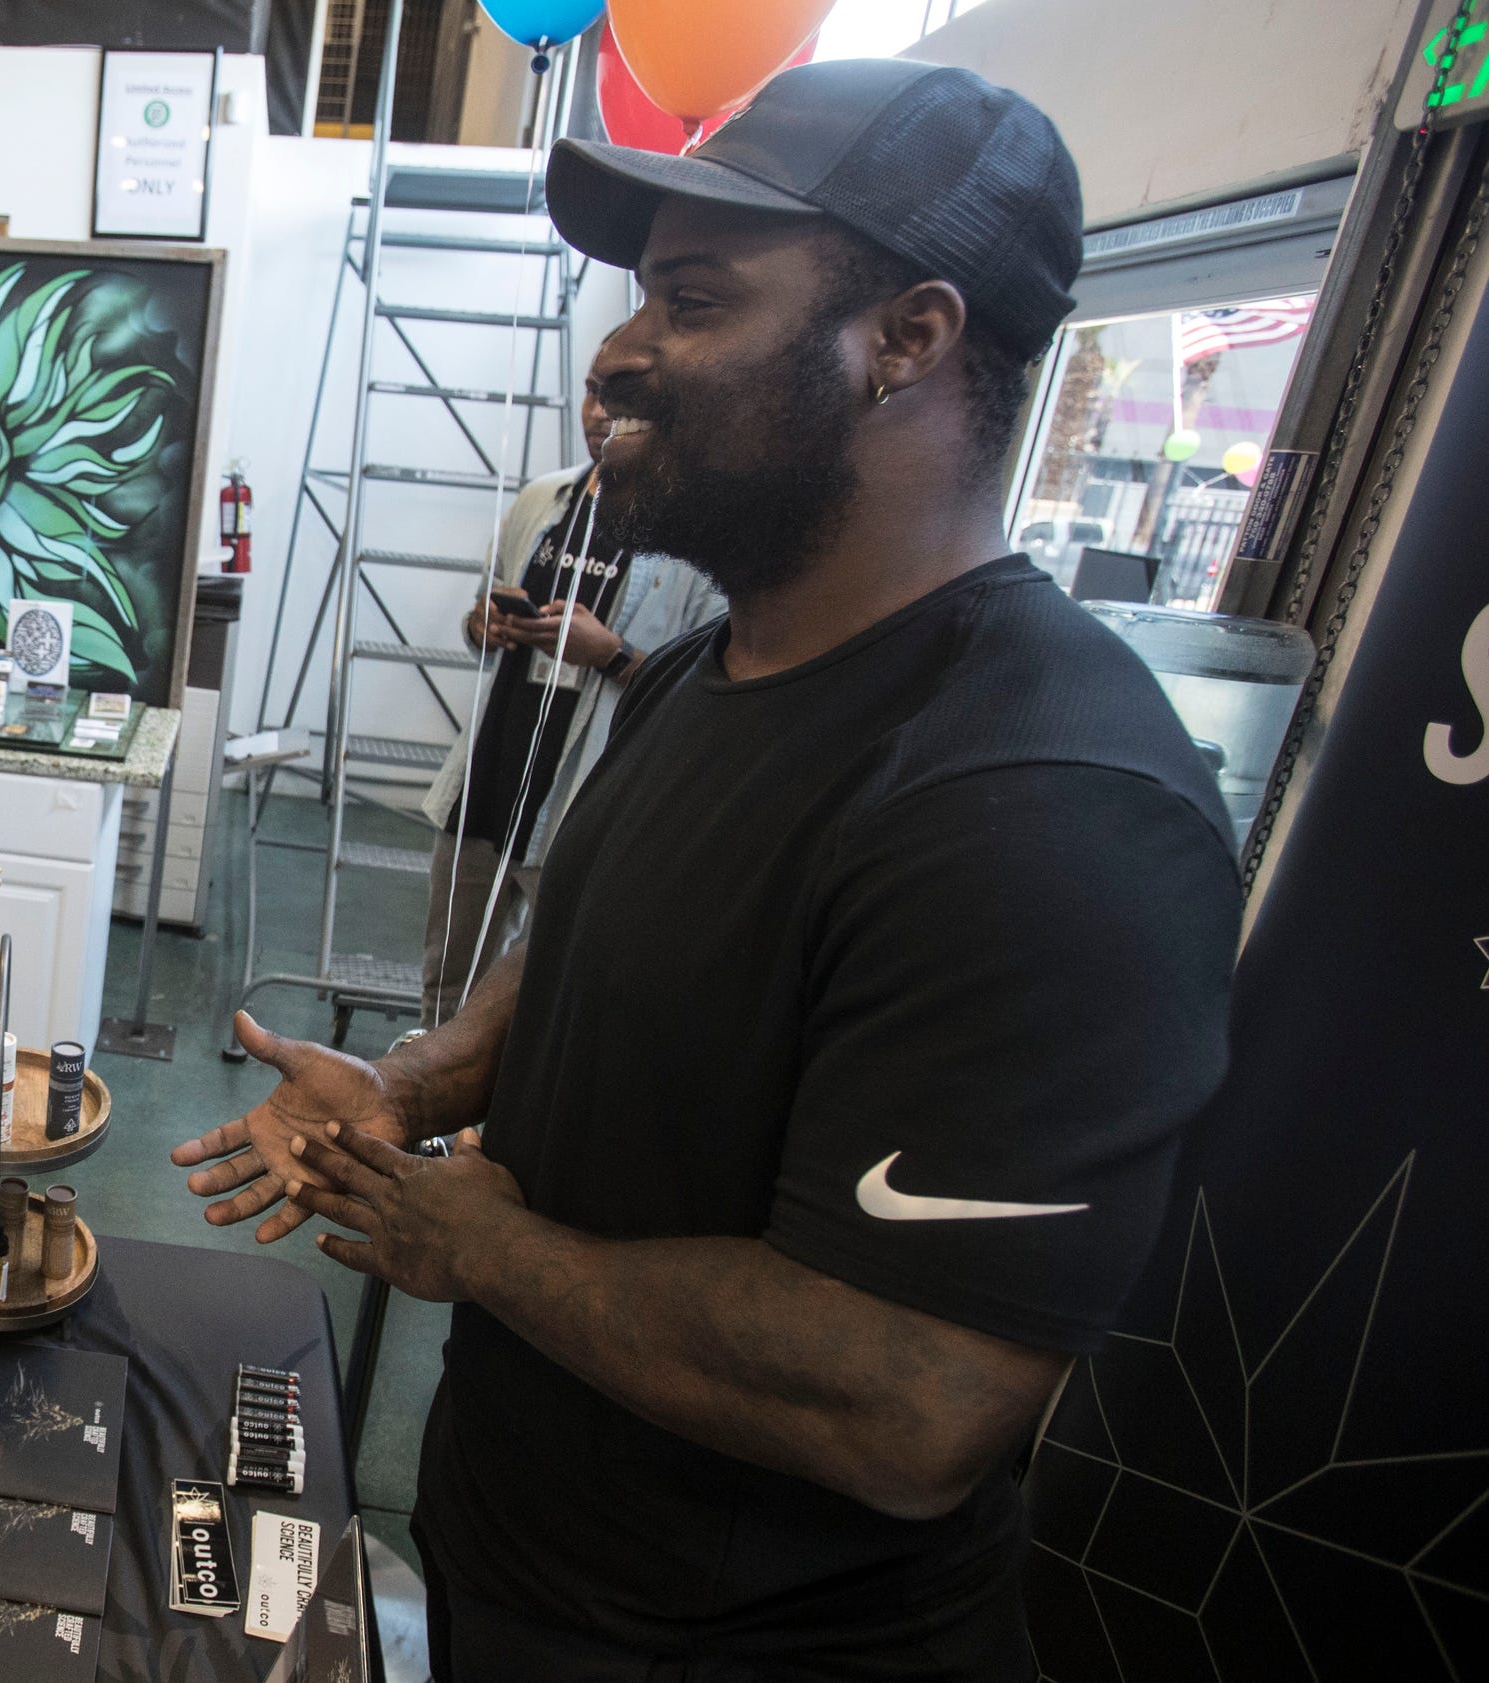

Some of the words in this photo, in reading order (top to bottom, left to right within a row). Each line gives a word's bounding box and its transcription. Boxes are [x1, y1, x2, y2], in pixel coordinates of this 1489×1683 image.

[1253, 193, 1297, 219] OCCUPIED
[1239, 518, 1253, 553] PATTON
[1251, 491, 1263, 516] DOOR
[1263, 456, 1275, 480] GATE
[258, 1396, 284, 1405] outco
[259, 1381, 285, 1391] outco
[257, 1411, 285, 1420] outco
[242, 1431, 269, 1440] outco
[241, 1468, 269, 1478] outco
[279, 1521, 295, 1562] SCIENCE
[297, 1524, 313, 1588] BEAUTIFULLY
[192, 1528, 219, 1599] outco
[259, 1594, 269, 1627] outco
[71, 1616, 83, 1654] BEAUTIFULLY
